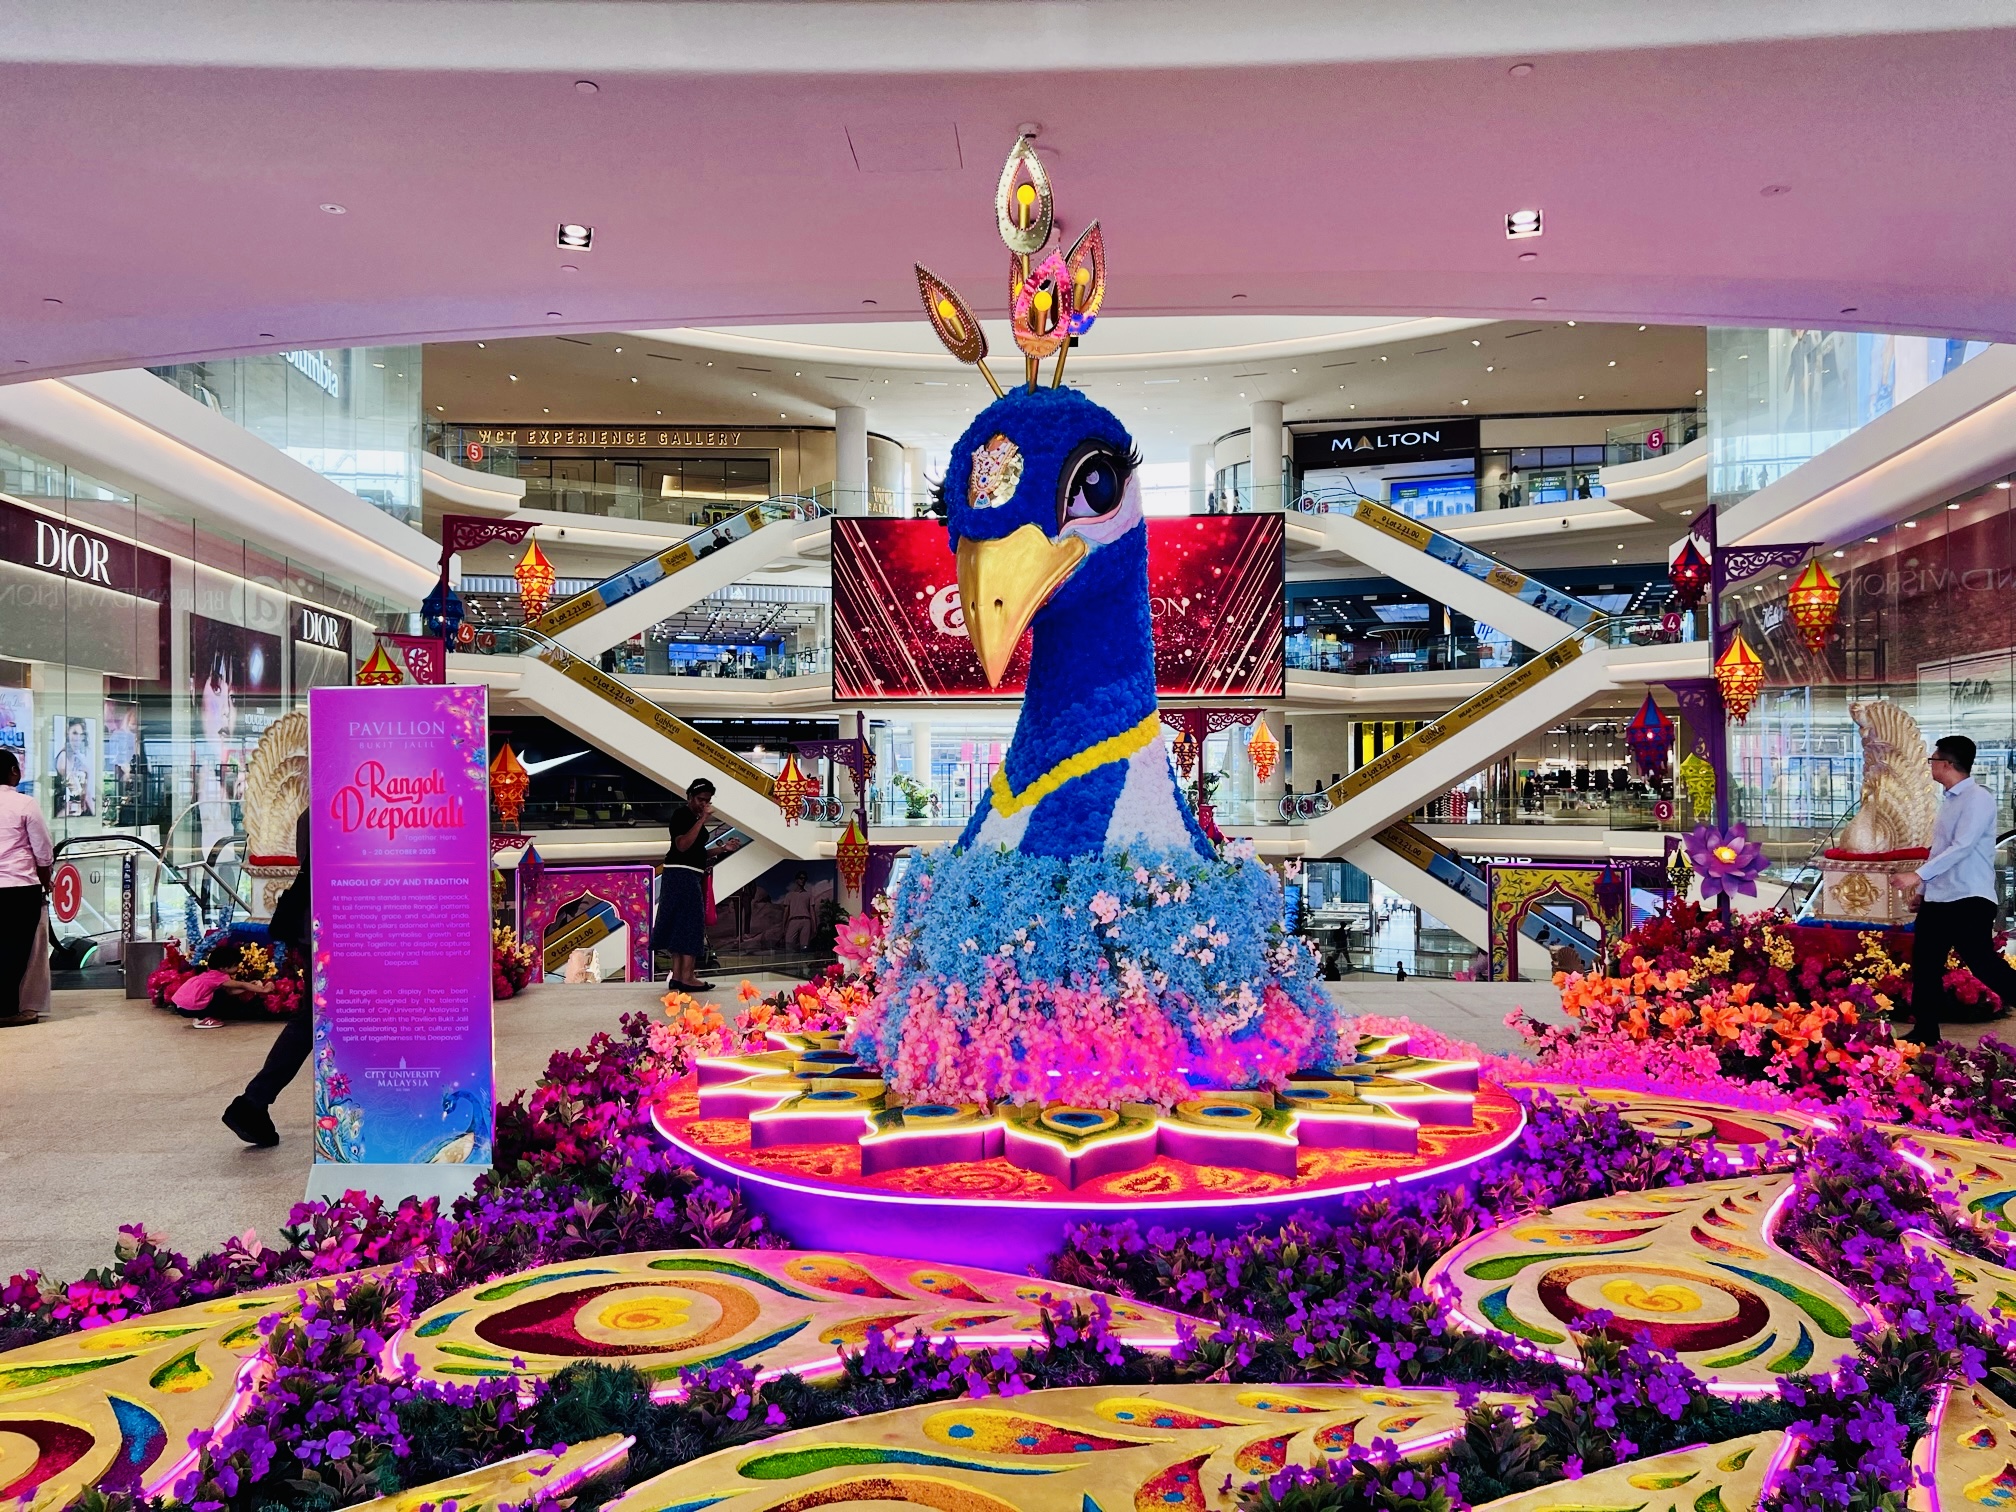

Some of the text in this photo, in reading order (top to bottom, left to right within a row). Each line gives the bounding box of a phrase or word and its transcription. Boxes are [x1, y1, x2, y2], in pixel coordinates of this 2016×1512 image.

[279, 350, 339, 398] lumbia
[478, 430, 742, 446] WCT EXPERIENCE GALLERY
[470, 445, 479, 460] 5
[1386, 518, 1420, 539] Lot 2.21.00
[34, 519, 112, 586] DIOR
[555, 600, 592, 623] Lot 2.21.00
[302, 608, 340, 649] DIOR
[1477, 621, 1494, 640] hp
[597, 678, 635, 705] Lot 2.21.00
[349, 720, 445, 737] PAVILION
[359, 741, 435, 749] BUKIT JALIL
[1379, 752, 1401, 770] 2.21.00
[355, 761, 447, 804] Rangoli
[331, 785, 466, 840] Deepavali
[331, 879, 369, 887] RANGOLI
[383, 878, 401, 886] JOY
[402, 878, 422, 886] AND
[423, 877, 469, 886] TRADITION
[56, 875, 74, 913] 3
[556, 927, 594, 955] Lot 2.21.00
[364, 1070, 441, 1079] CITY UNIVERSITY
[377, 1079, 429, 1087] MALAYSIA
